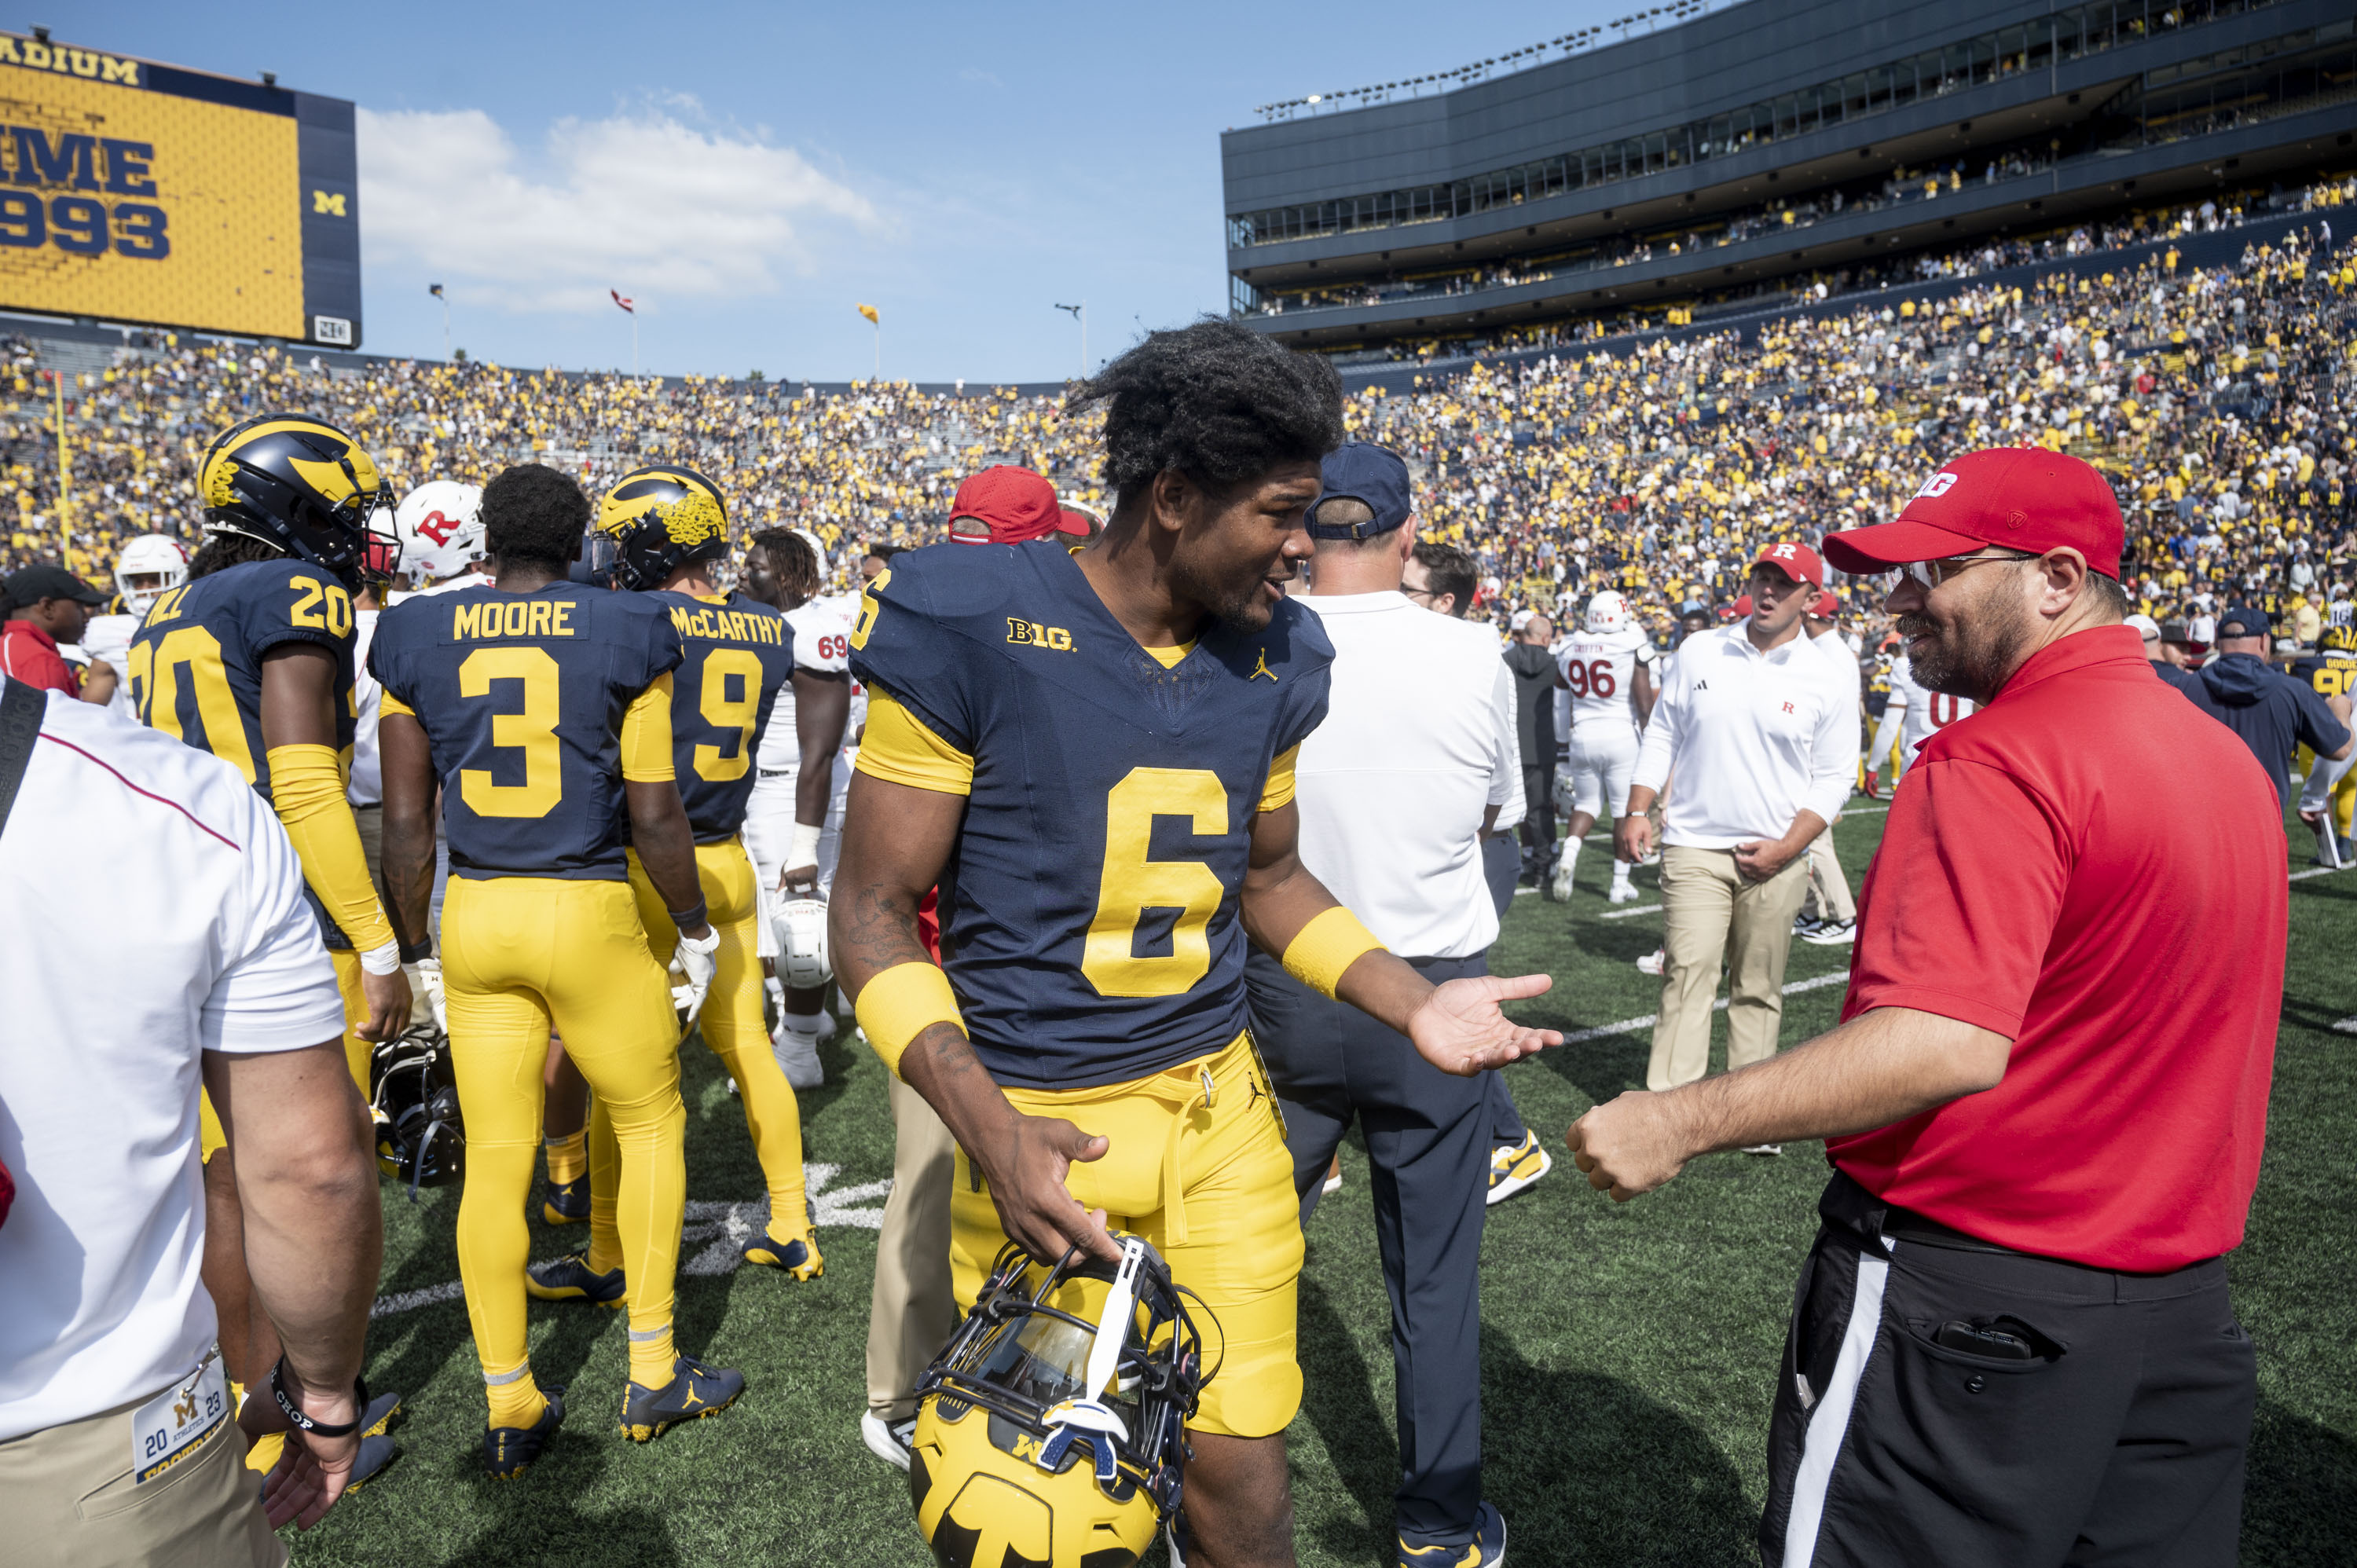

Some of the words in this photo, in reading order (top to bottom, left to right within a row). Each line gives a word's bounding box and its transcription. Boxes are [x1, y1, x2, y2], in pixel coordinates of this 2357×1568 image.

[0, 124, 158, 198] ME
[313, 189, 346, 218] M
[417, 510, 461, 548] R
[1772, 544, 1797, 560] R
[290, 575, 353, 639] 20
[454, 601, 577, 640] MOORE
[850, 568, 892, 651] 6
[818, 636, 847, 659] 69
[1568, 659, 1616, 699] 96
[693, 648, 764, 782] 9
[1781, 702, 1795, 714] R
[459, 647, 563, 818] 3
[1081, 767, 1229, 998] 6
[174, 1394, 198, 1428] M
[206, 1390, 221, 1419] 23
[276, 1390, 314, 1429] CHOP
[145, 1428, 167, 1459] 20
[173, 1416, 205, 1443] ATHLETICS
